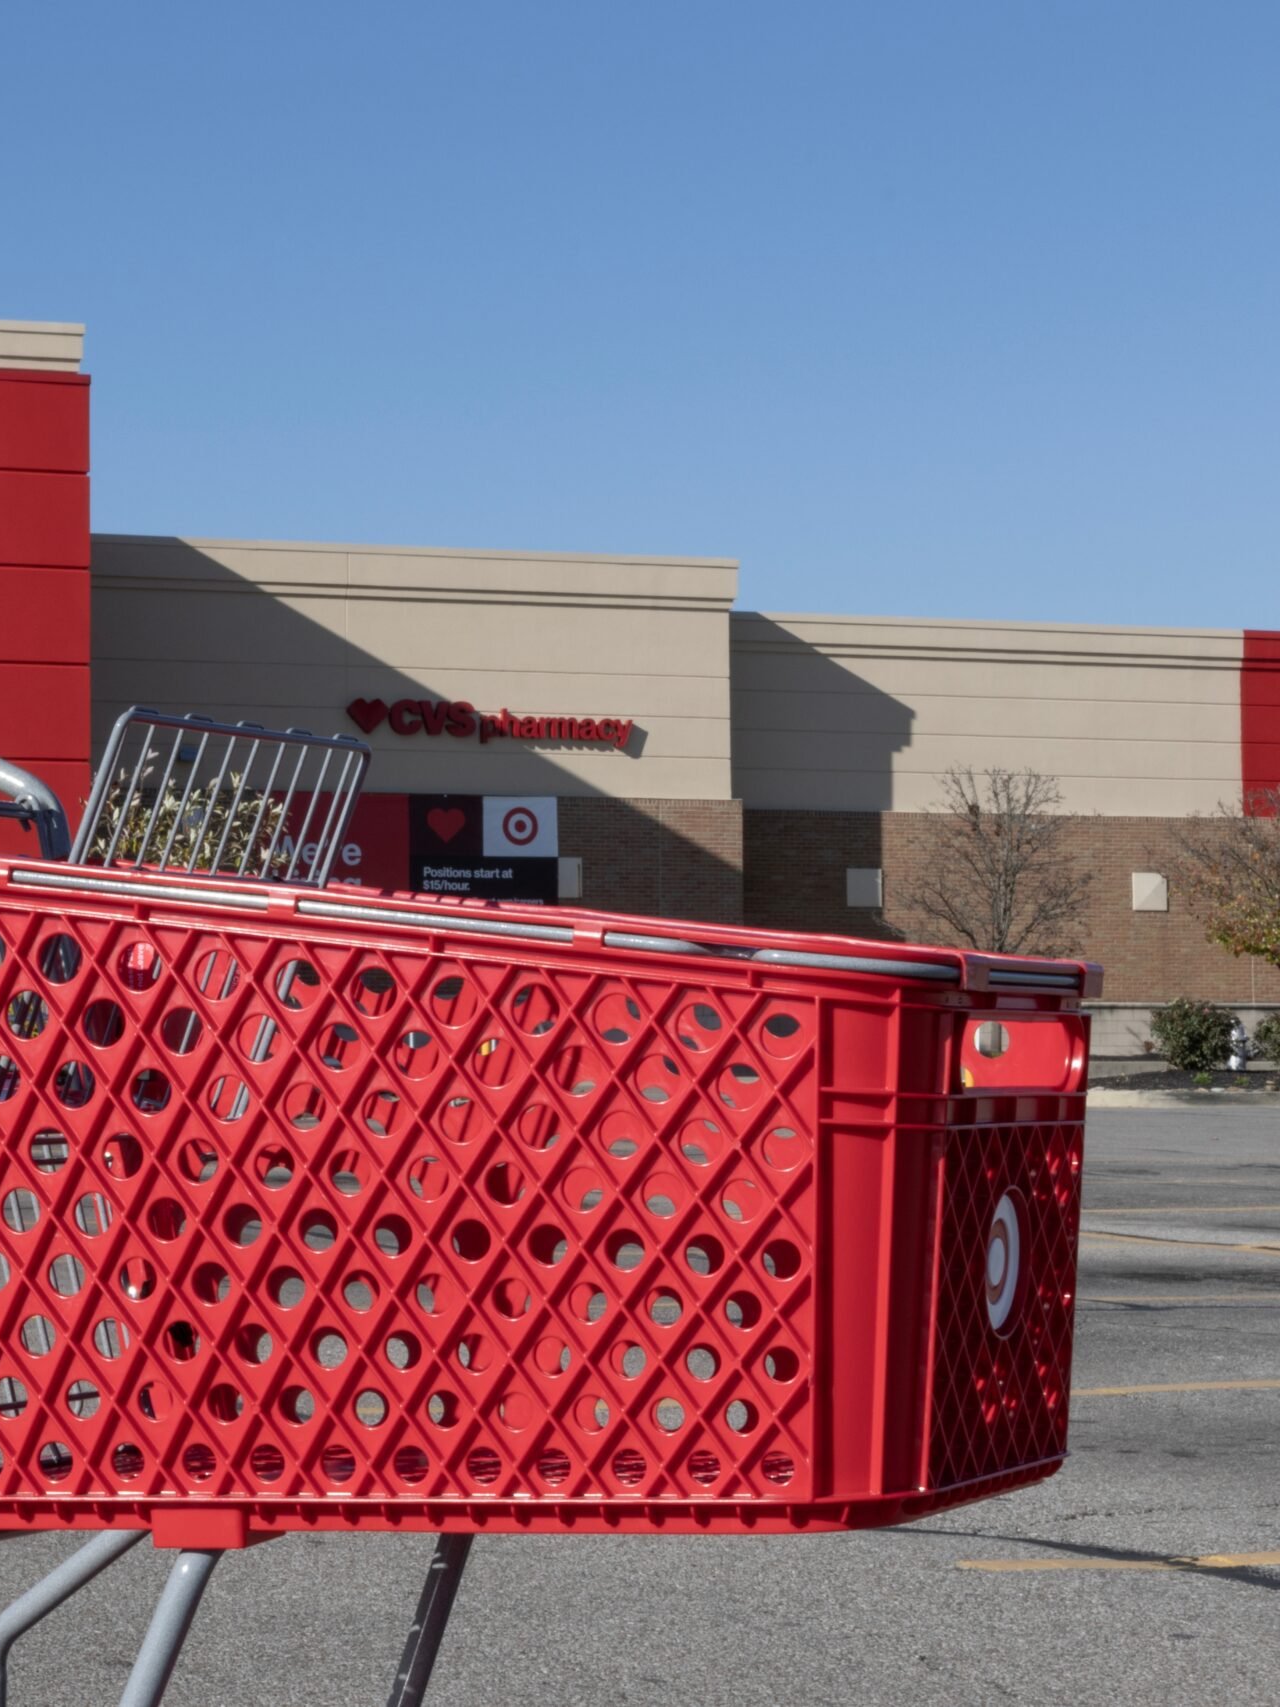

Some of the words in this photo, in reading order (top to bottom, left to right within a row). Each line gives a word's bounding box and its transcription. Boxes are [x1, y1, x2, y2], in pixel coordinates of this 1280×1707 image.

[388, 699, 475, 738] CVS
[479, 708, 633, 748] pharmacy
[423, 866, 472, 878] Positions
[473, 868, 500, 879] start
[501, 868, 513, 879] at
[423, 880, 470, 891] $15/hour.
